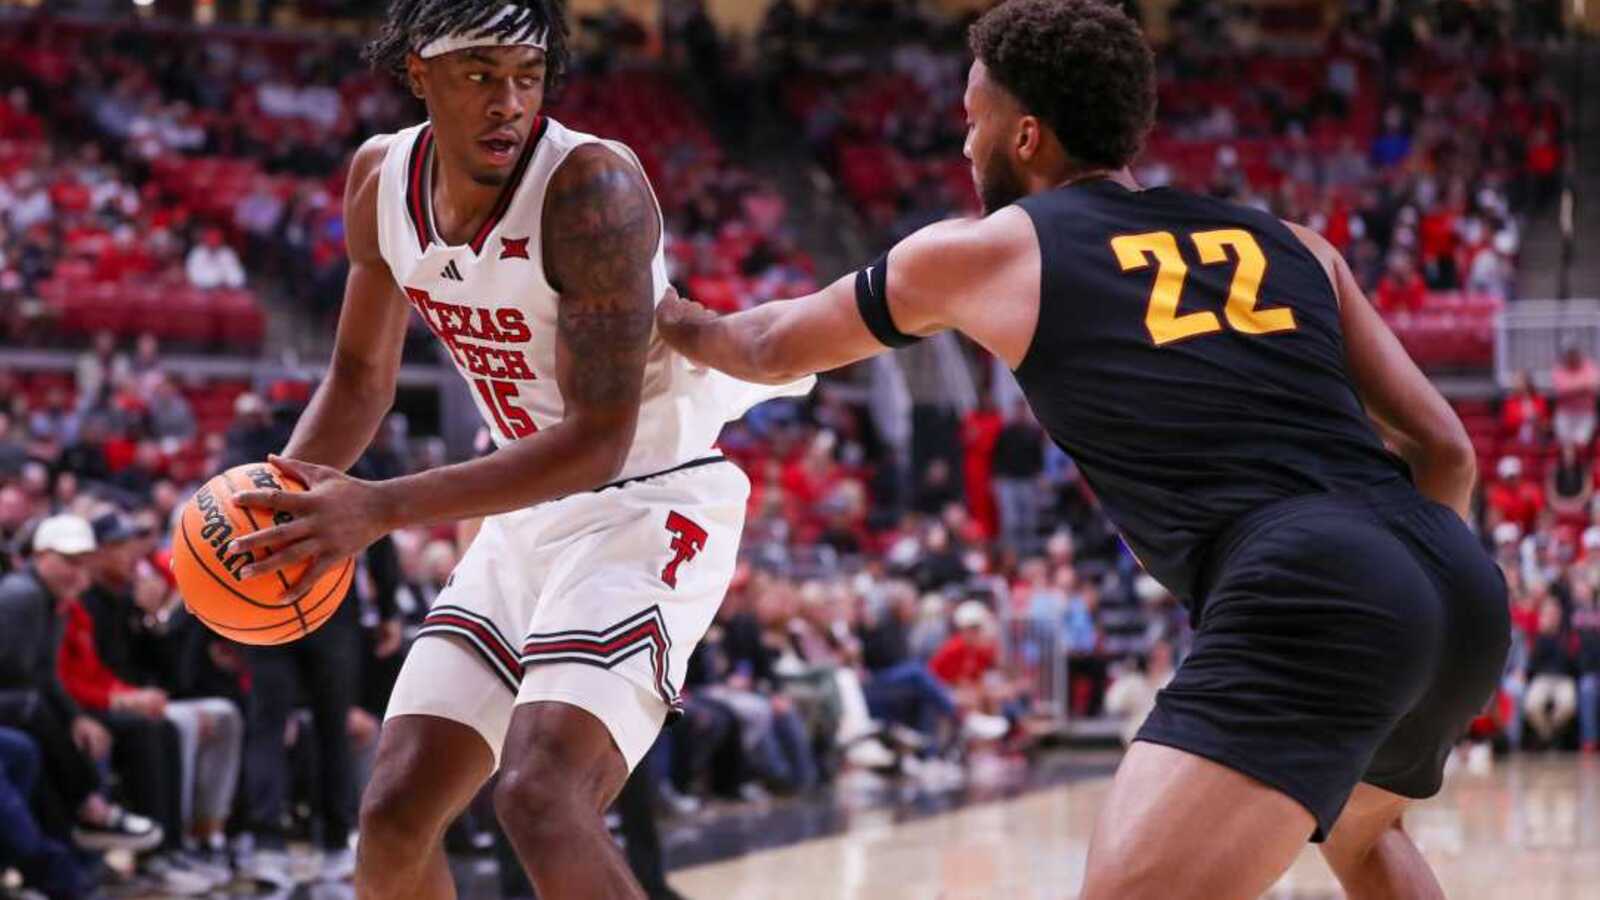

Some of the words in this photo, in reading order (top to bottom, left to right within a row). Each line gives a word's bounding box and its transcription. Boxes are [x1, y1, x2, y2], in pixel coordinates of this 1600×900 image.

[404, 286, 532, 343] TEXAS
[1108, 228, 1297, 347] 22
[442, 332, 537, 381] TECH
[474, 378, 539, 440] 15
